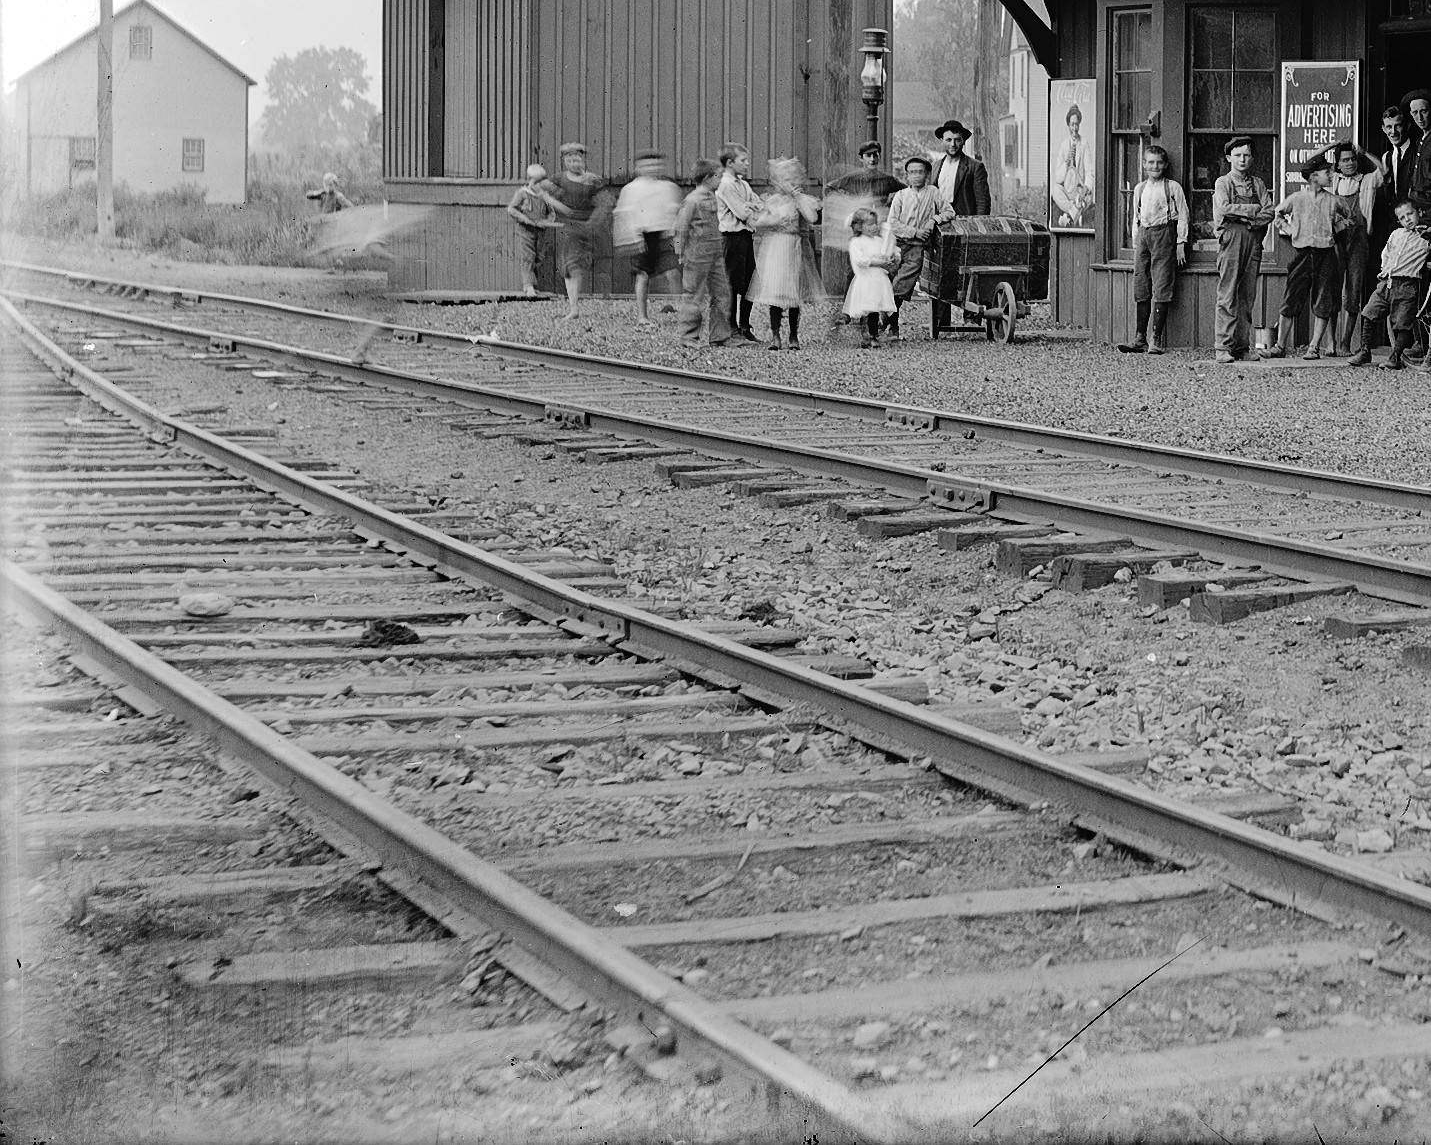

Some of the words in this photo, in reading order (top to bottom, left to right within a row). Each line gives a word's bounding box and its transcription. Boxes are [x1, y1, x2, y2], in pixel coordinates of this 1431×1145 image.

[1311, 91, 1330, 101] FOR
[1287, 103, 1352, 128] ADVERTISING
[1303, 128, 1337, 144] HERE
